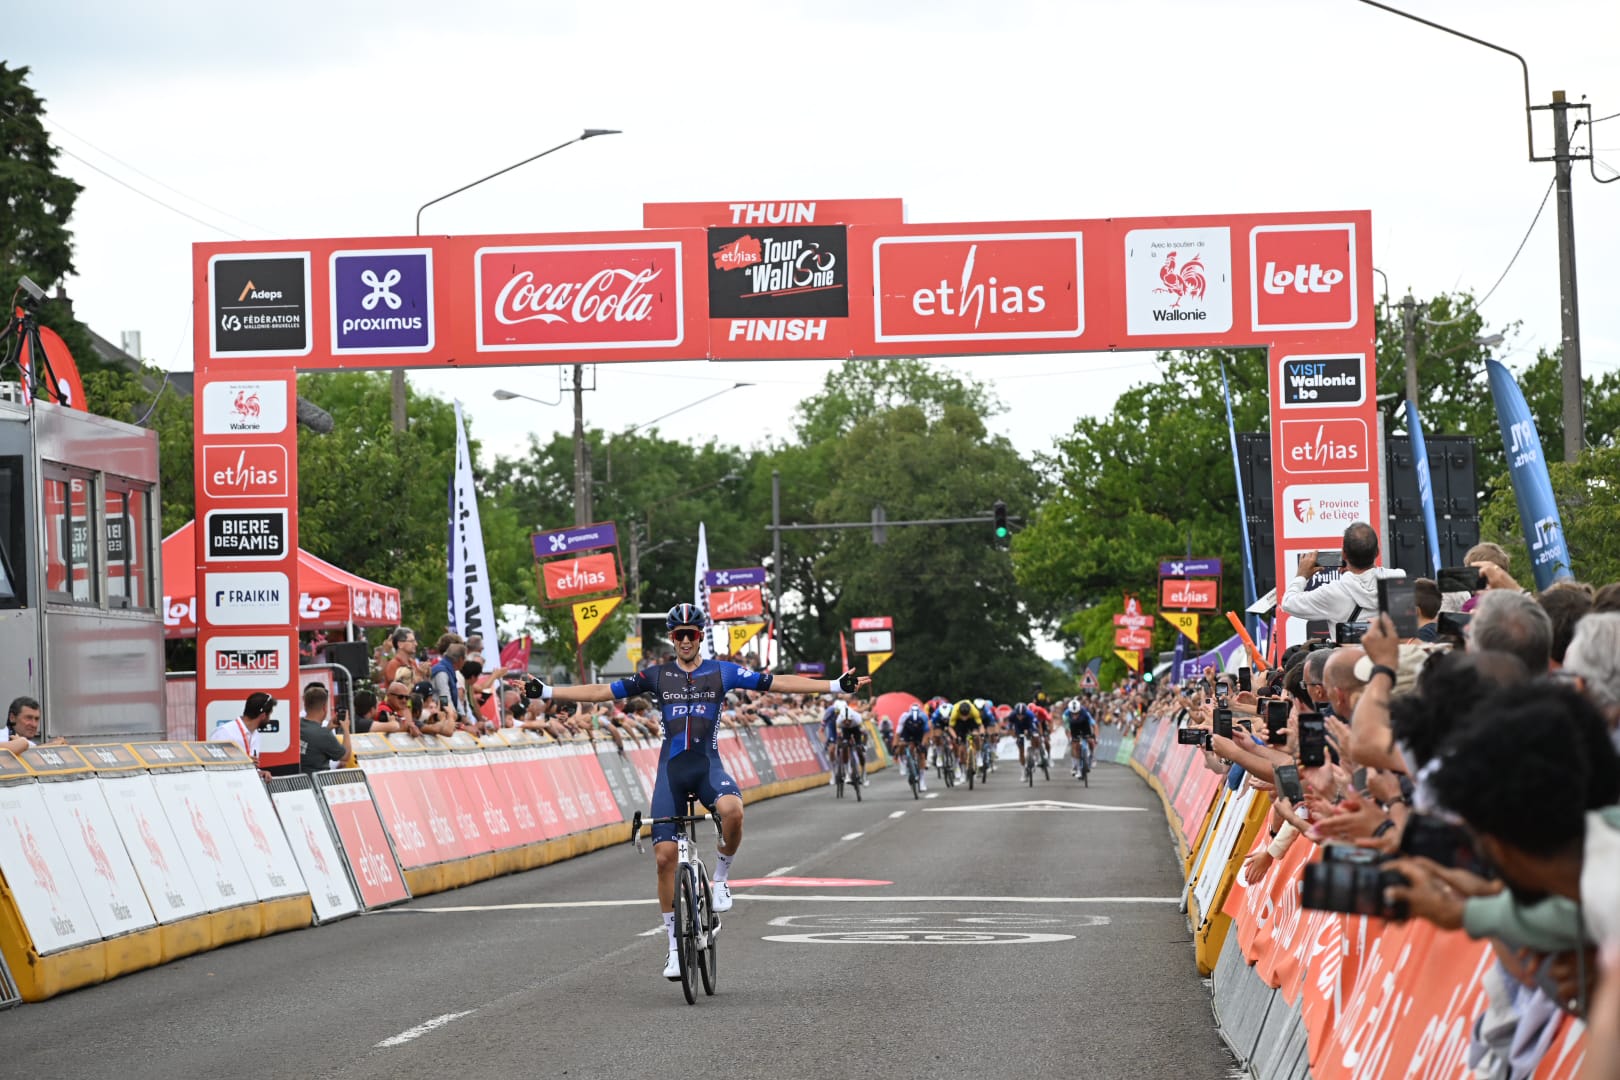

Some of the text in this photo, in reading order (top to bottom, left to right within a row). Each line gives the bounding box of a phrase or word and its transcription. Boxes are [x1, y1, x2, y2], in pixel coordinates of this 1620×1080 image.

[728, 202, 816, 224] THUIN
[721, 242, 757, 265] ethias
[763, 238, 803, 264] Tour
[912, 244, 1046, 329] ethias
[251, 290, 283, 301] Adeps
[494, 267, 663, 325] Coca-Cola
[243, 314, 300, 324] FÉDÉRATION
[1153, 308, 1207, 321] Wallonie
[343, 315, 422, 335] proximus
[728, 319, 827, 341] FINISH
[1289, 363, 1326, 376] VISIT
[1290, 373, 1356, 388] Wallonia
[1292, 388, 1318, 400] .be
[1291, 424, 1358, 467] ethias
[213, 450, 278, 491] ethias
[1319, 499, 1360, 508] Province
[1319, 509, 1360, 522] de Liège
[222, 519, 270, 535] BIERE
[568, 532, 599, 545] proximus
[556, 561, 605, 590] ethias
[229, 589, 280, 602] FRAIKIN
[1171, 582, 1208, 605] ethias
[717, 592, 753, 615] ethias
[581, 604, 599, 620] 25
[1180, 616, 1192, 627] 50
[734, 629, 747, 639] 50
[218, 653, 277, 669] DELRUE
[352, 809, 393, 898] ethias
